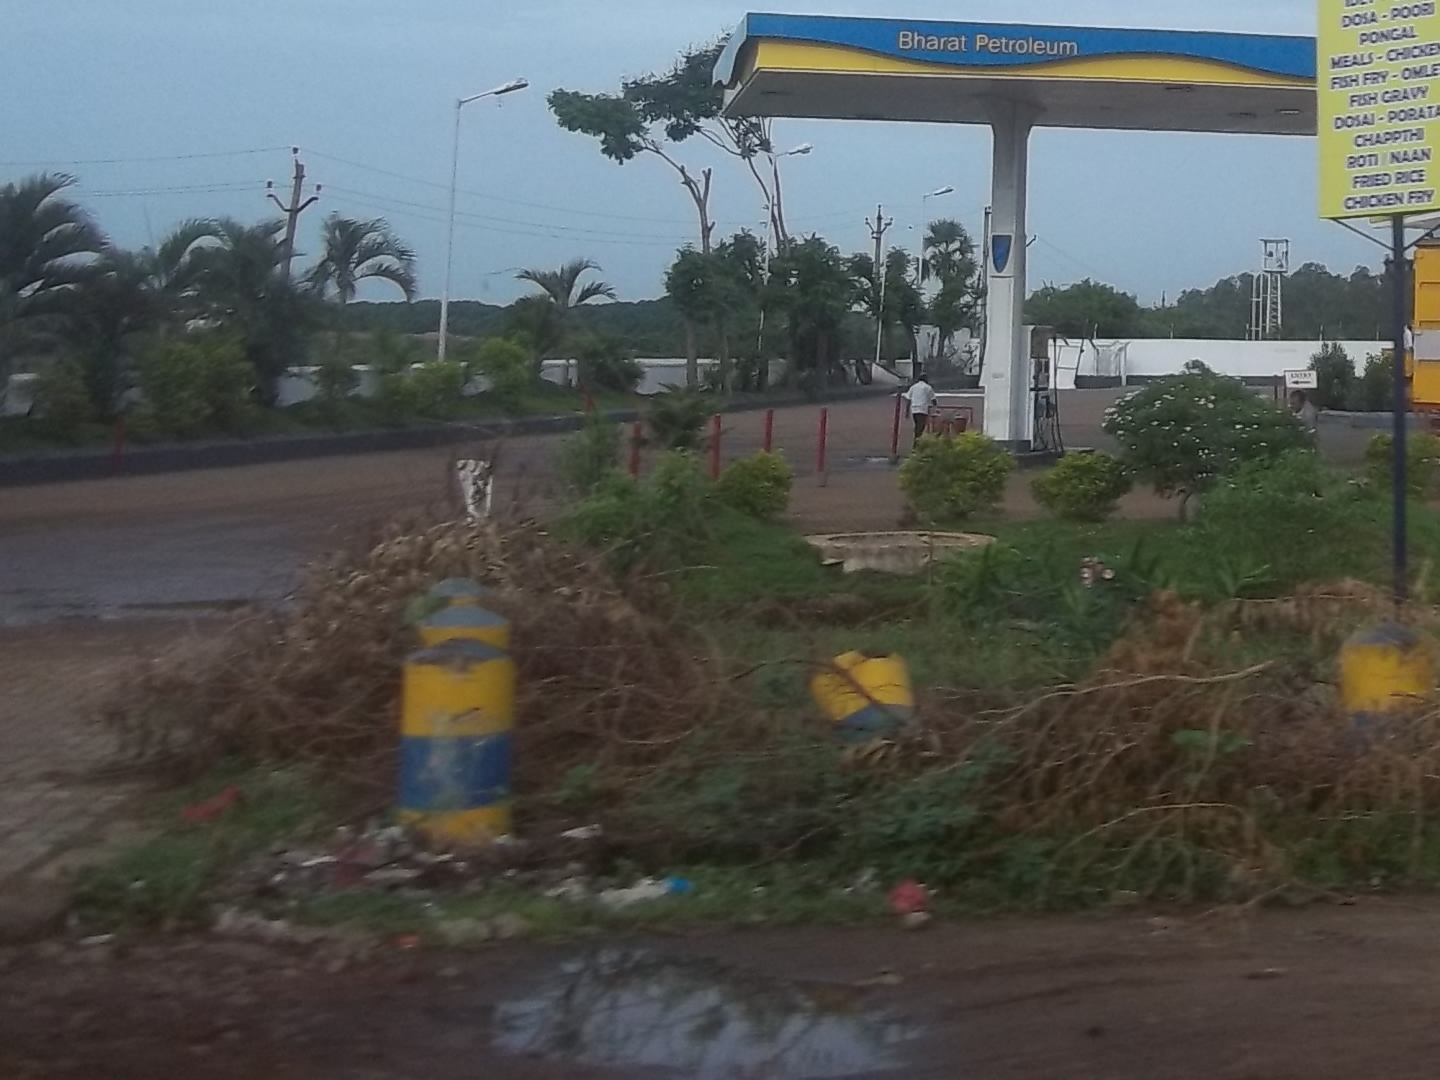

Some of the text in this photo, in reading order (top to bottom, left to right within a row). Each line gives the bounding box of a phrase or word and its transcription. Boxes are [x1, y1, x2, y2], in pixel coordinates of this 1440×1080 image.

[1341, 11, 1378, 28] DOSA
[1390, 2, 1435, 20] POORI
[898, 31, 1078, 56] Bharat Petroleum
[1359, 26, 1418, 45] PONGAL
[1330, 52, 1374, 69] MEALS
[1330, 75, 1359, 90] FISH
[1362, 71, 1389, 86] FRY
[1349, 86, 1429, 108] FISH GRAVY
[1334, 113, 1376, 130] DOSAI
[1347, 148, 1432, 168] ROTI NAAN
[1352, 169, 1426, 189] FRIED RICE
[1344, 190, 1435, 210] CHICKEN FRY
